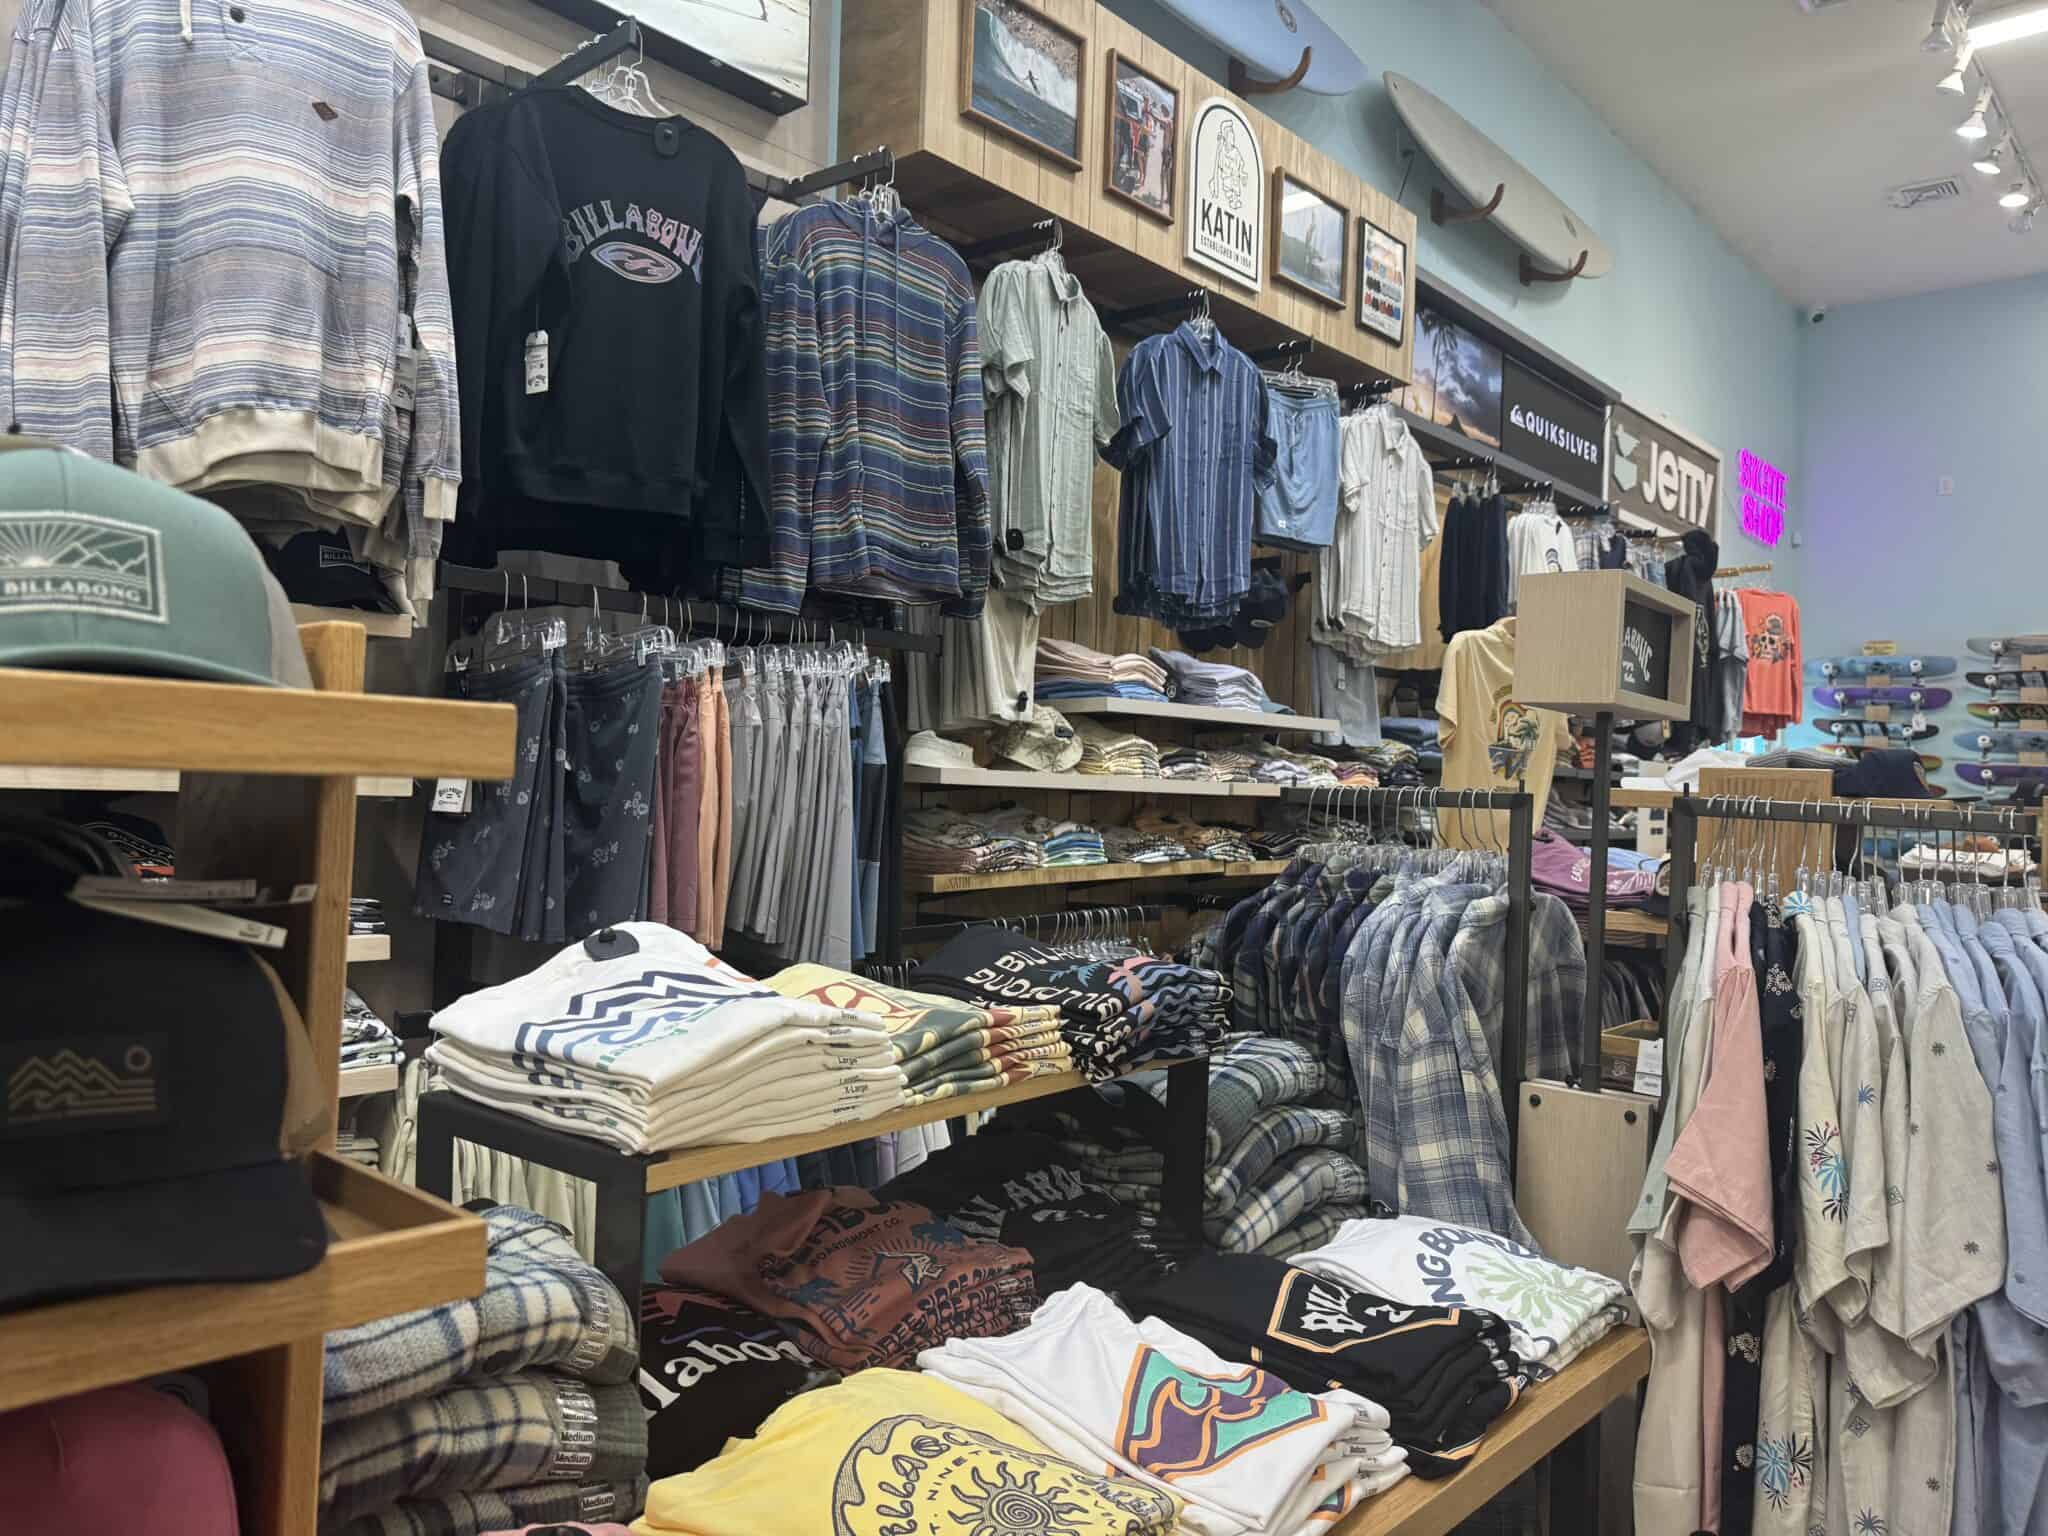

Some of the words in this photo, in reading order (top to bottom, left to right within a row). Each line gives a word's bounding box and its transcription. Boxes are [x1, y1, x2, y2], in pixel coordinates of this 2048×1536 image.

[1202, 198, 1252, 256] KATIN
[1526, 411, 1598, 464] QUIKSILVER
[1739, 448, 1788, 512] SKATE
[1742, 494, 1784, 546] SHOP
[4, 580, 142, 602] BILLABONG
[555, 1453, 591, 1464] Medium
[561, 1431, 594, 1442] Medium
